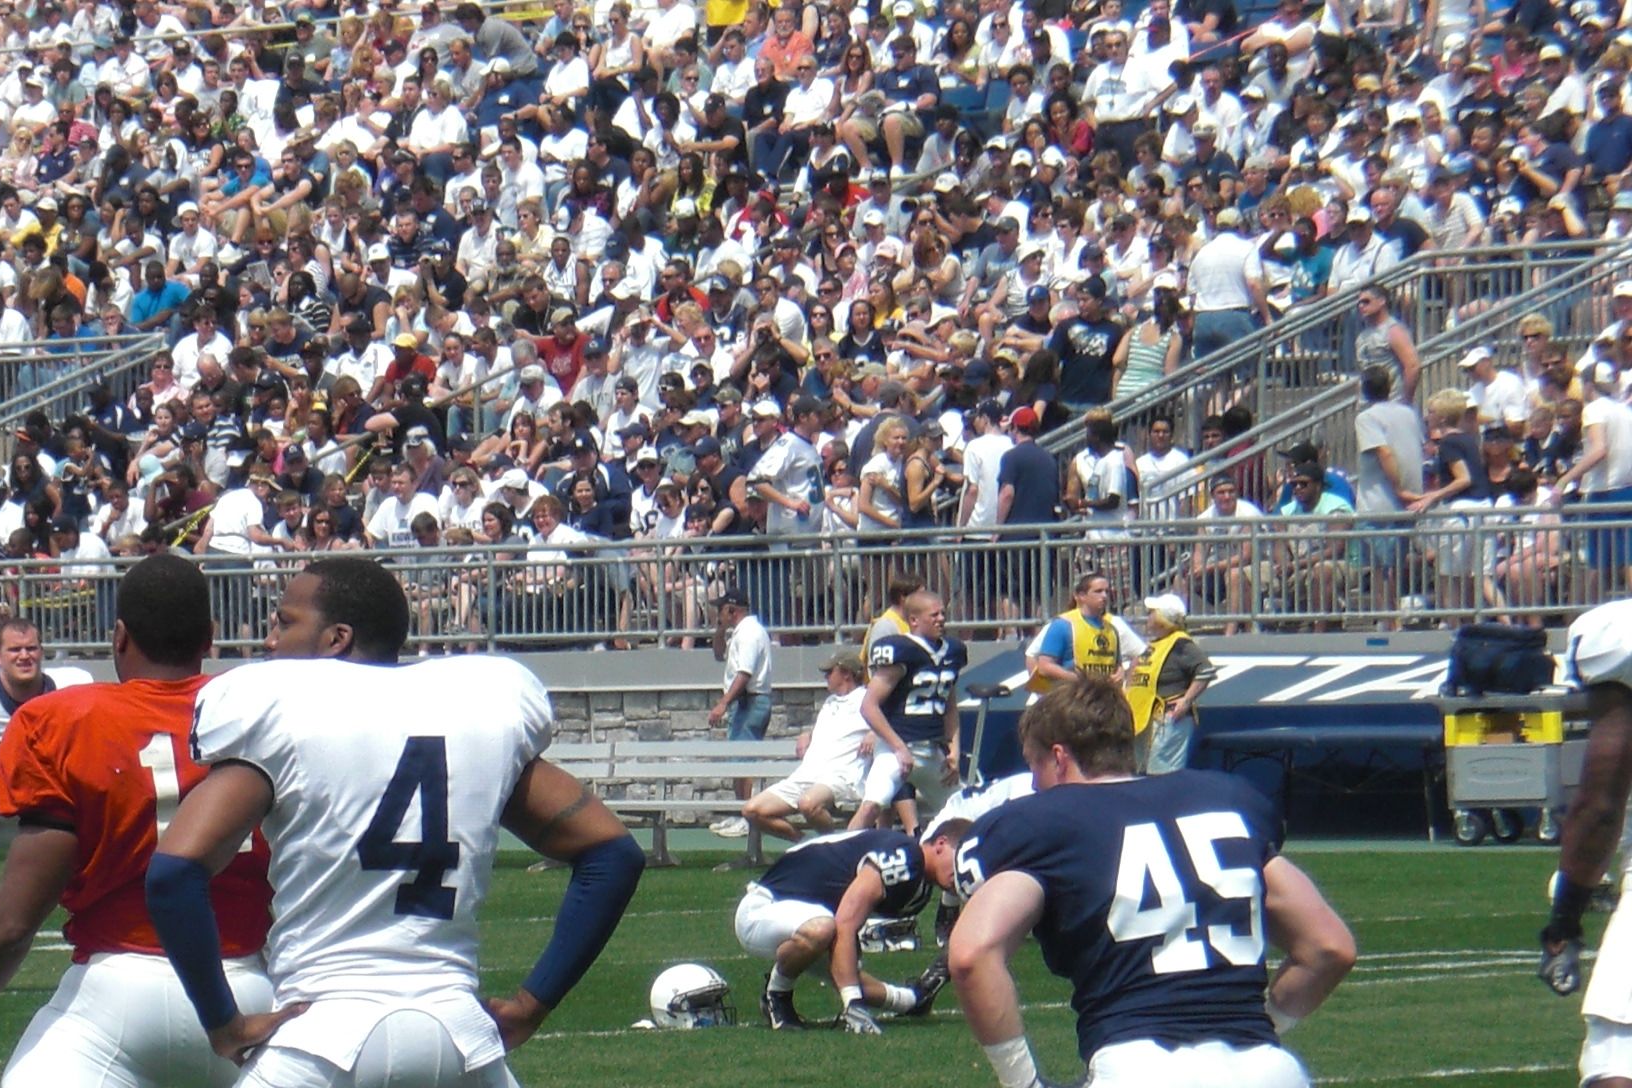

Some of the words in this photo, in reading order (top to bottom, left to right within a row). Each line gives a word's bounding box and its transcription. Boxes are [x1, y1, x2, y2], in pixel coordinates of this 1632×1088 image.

[904, 670, 956, 716] 29
[357, 735, 460, 921] 4
[956, 836, 985, 896] 5
[1106, 811, 1267, 975] 45
